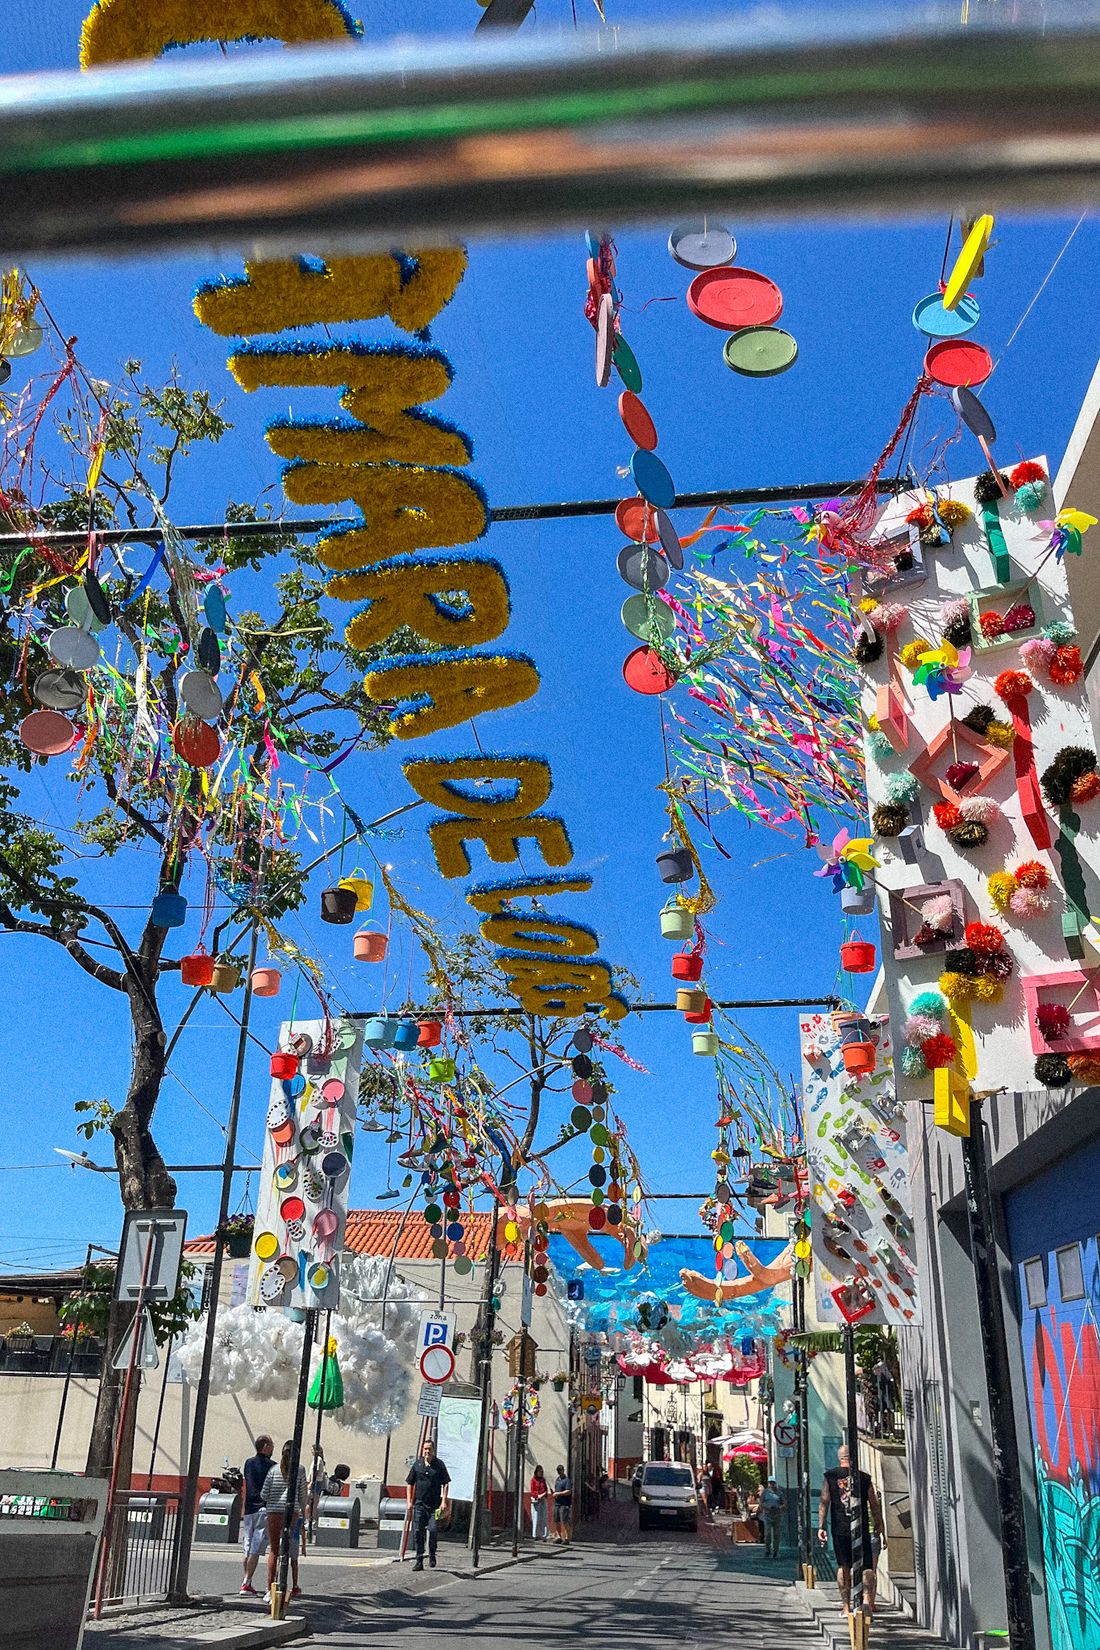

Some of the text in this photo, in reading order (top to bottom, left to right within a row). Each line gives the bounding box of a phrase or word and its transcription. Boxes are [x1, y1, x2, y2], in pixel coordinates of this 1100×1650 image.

[402, 752, 574, 880] DE
[465, 871, 630, 1021] LOBOS
[428, 1324, 444, 1345] P
